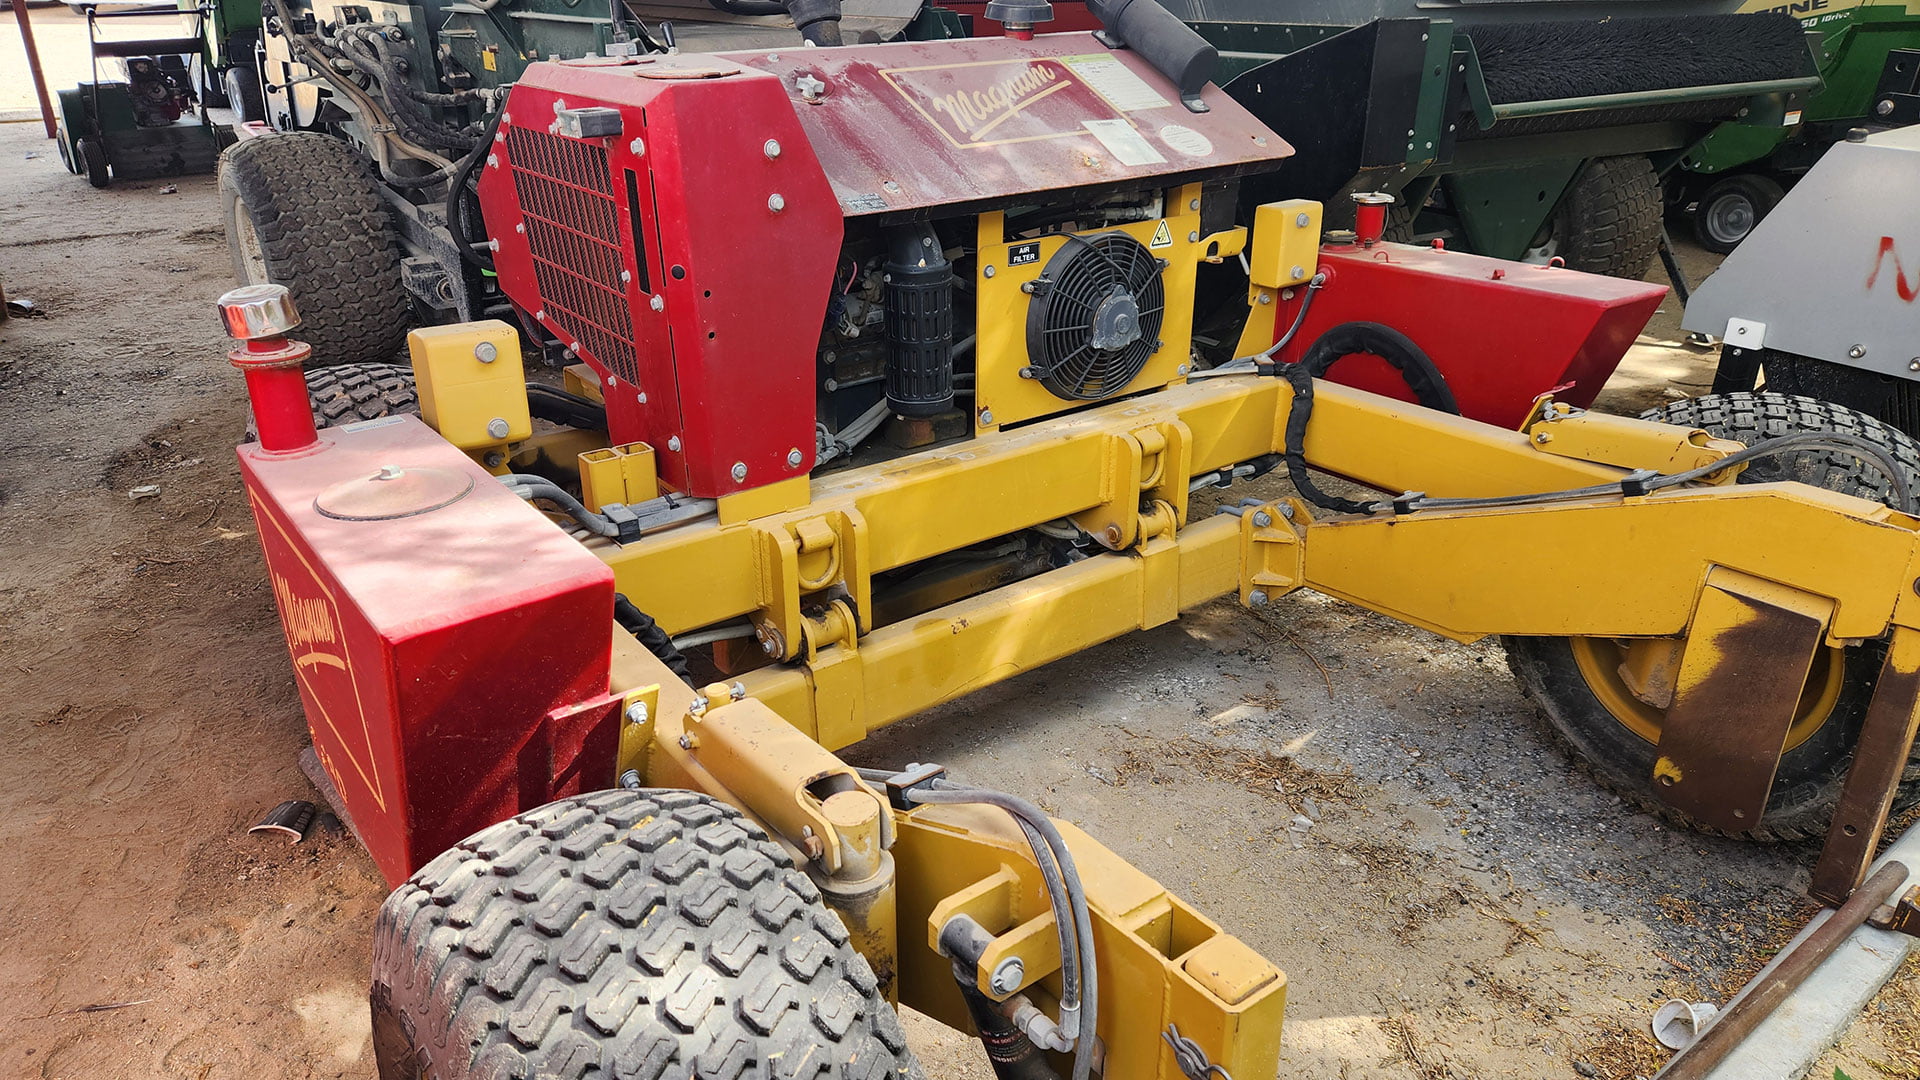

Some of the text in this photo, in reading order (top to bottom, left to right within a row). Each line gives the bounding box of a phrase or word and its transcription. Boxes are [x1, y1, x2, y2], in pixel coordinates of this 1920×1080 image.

[932, 64, 1056, 133] Magnum
[1013, 253, 1035, 263] FILTER
[1019, 246, 1030, 254] AIR
[276, 572, 336, 672] Magnum
